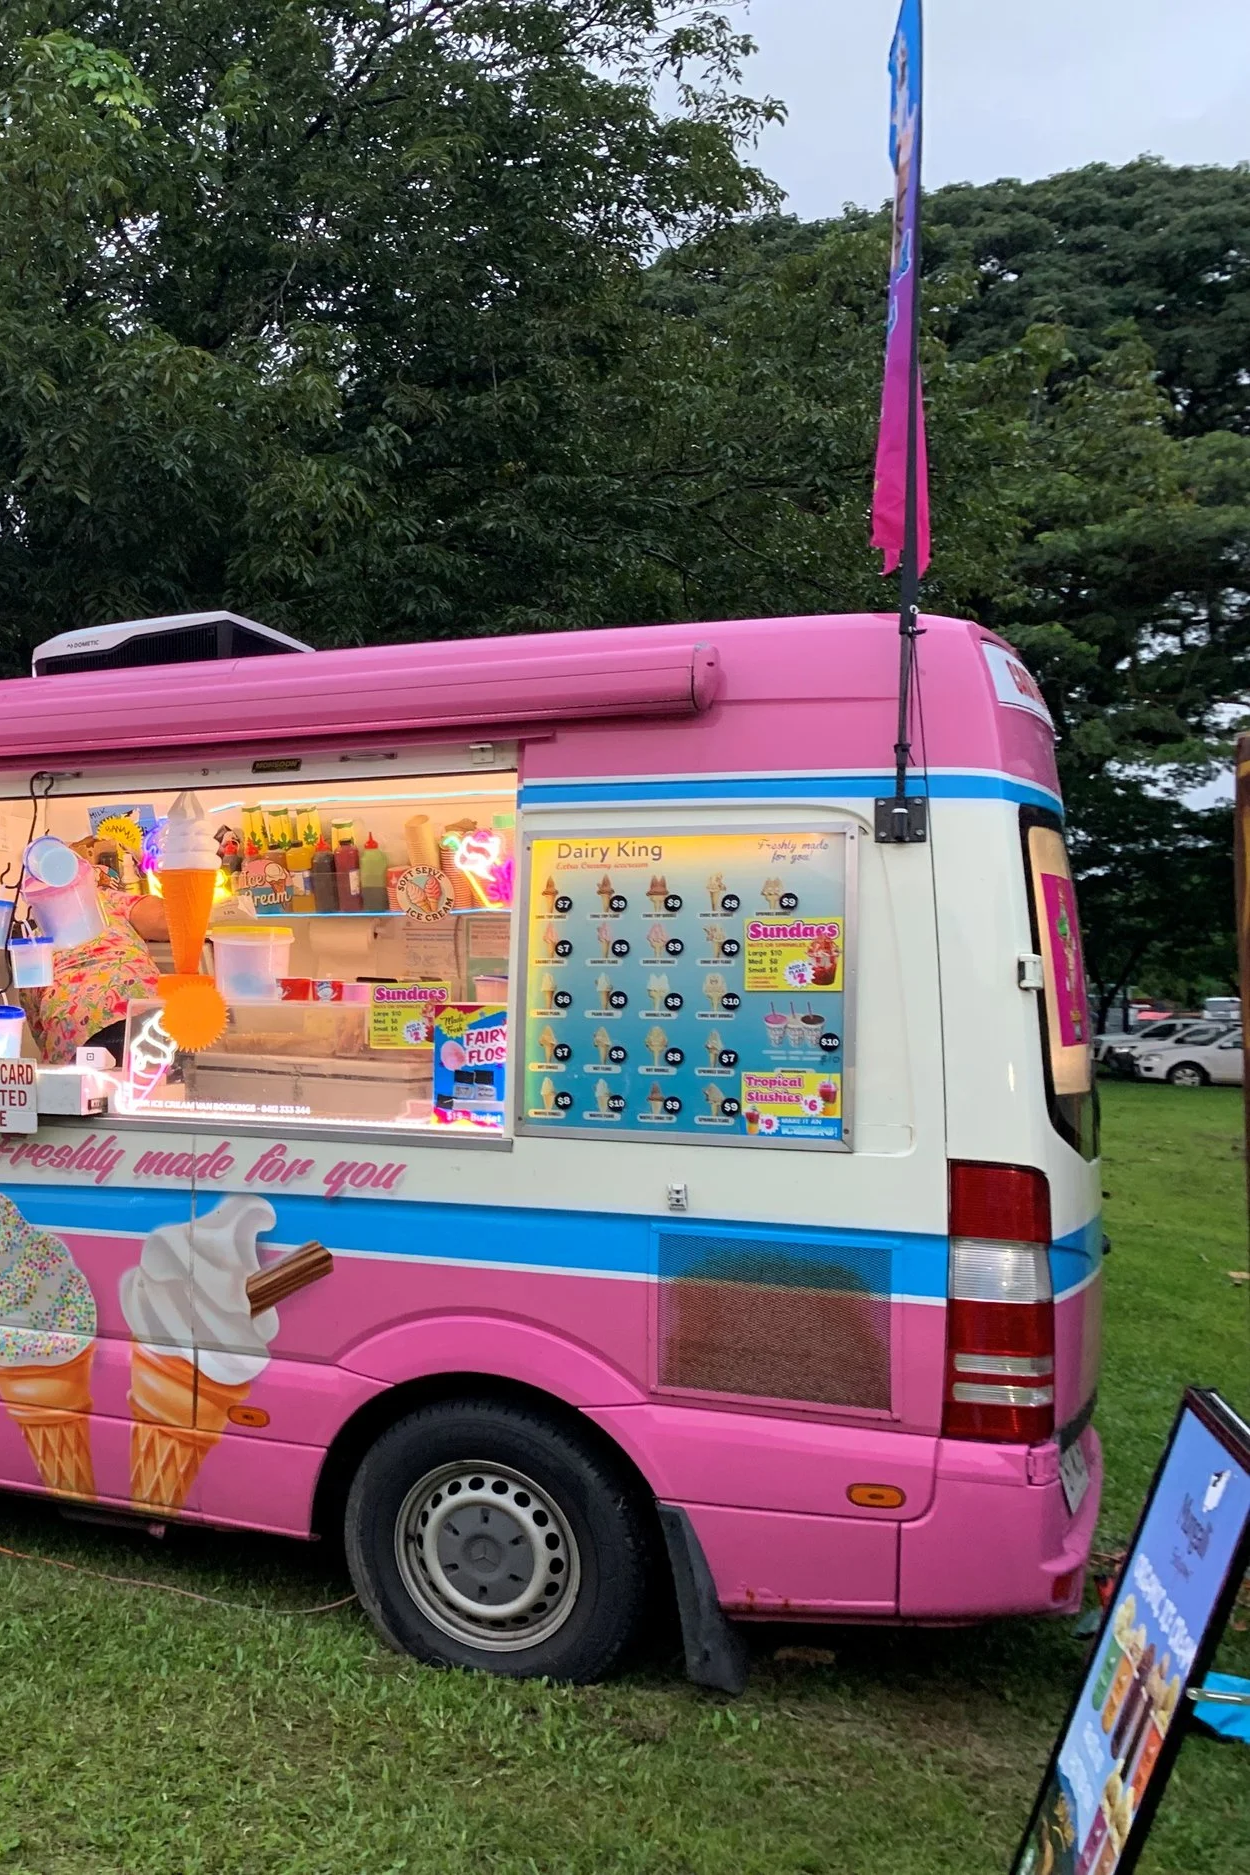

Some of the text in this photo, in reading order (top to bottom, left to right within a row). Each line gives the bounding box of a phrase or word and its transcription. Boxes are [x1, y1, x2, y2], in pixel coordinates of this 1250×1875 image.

[74, 640, 99, 648] DOMETIC
[758, 839, 829, 853] Freshly made
[557, 841, 663, 863] Dairy King
[771, 851, 786, 863] for
[398, 866, 445, 892] SOFT SERVE
[557, 899, 570, 909] $7
[612, 899, 626, 909] $9
[667, 898, 681, 908] $9
[724, 899, 738, 909] $8
[781, 897, 796, 907] $9
[406, 897, 454, 922] ICE CREAM
[747, 920, 840, 941] Sundaes
[557, 944, 570, 954] $7
[614, 943, 628, 953] $9
[667, 942, 682, 952] $9
[724, 943, 738, 953] $9
[375, 984, 448, 1004] Sundaes
[557, 995, 570, 1004] $6
[611, 995, 625, 1005] $8
[667, 997, 681, 1007] $8
[722, 997, 740, 1006] $10
[441, 1014, 464, 1026] Made
[465, 1028, 506, 1047] FAIRY
[821, 1038, 839, 1047] $10
[468, 1047, 506, 1064] FLOS
[556, 1048, 569, 1057] $7
[611, 1050, 625, 1059] $9
[667, 1052, 681, 1062] $8
[721, 1053, 735, 1064] $7
[0, 1064, 34, 1085] CARD
[744, 1073, 804, 1090] Tropical
[557, 1096, 571, 1106] $8
[745, 1089, 803, 1105] Slushies
[608, 1099, 625, 1108] $10
[666, 1100, 680, 1110] $9
[724, 1102, 738, 1112] $9
[804, 1099, 818, 1112] $6
[470, 1113, 502, 1123] Bucket
[760, 1118, 774, 1130] $9
[132, 1141, 236, 1180] made
[244, 1143, 316, 1185] for
[323, 1158, 409, 1200] you
